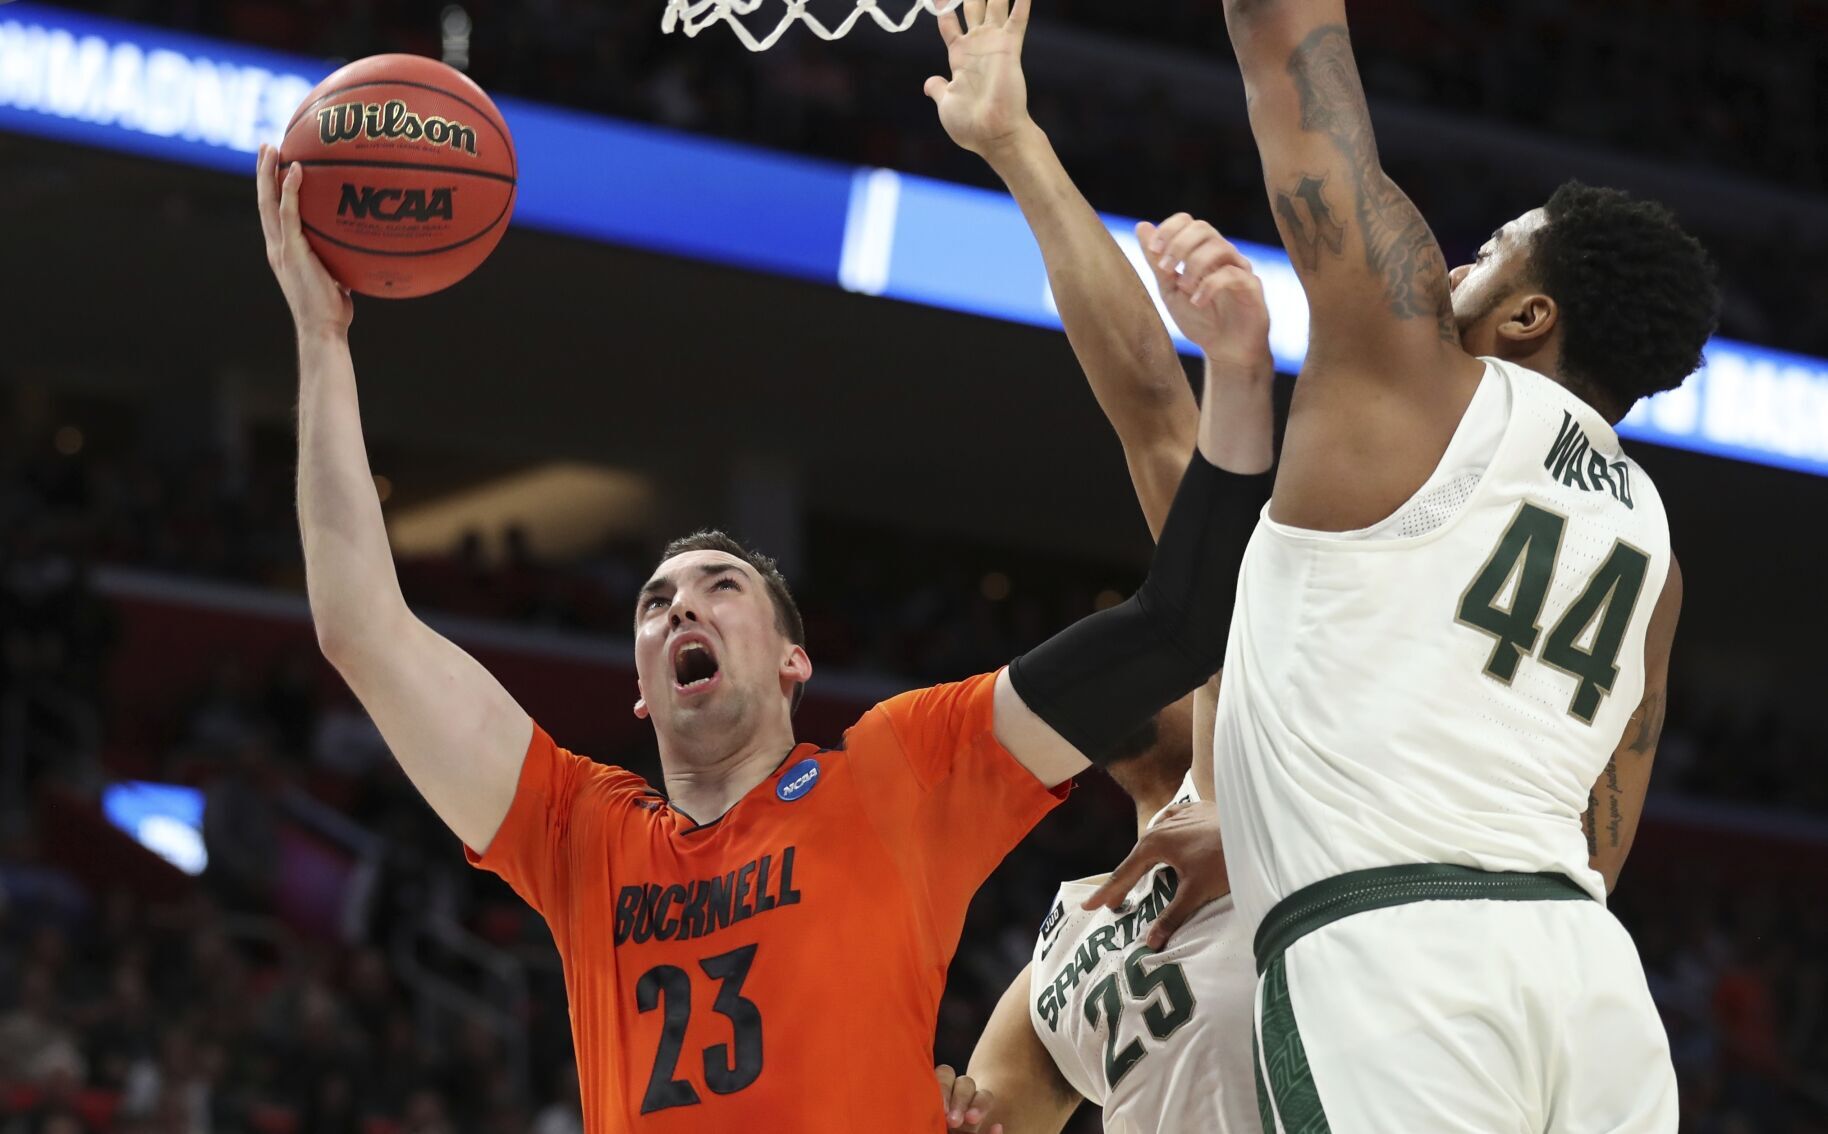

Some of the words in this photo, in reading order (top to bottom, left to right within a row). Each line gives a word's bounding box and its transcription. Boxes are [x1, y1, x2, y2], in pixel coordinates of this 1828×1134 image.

[317, 99, 478, 156] Wilson
[336, 183, 453, 222] NCAA
[1543, 408, 1634, 511] WARD
[1453, 499, 1652, 728] 44
[783, 767, 818, 797] NCAA
[615, 846, 801, 948] BUCKNELL
[635, 943, 764, 1116] 23
[1084, 946, 1197, 1094] 25
